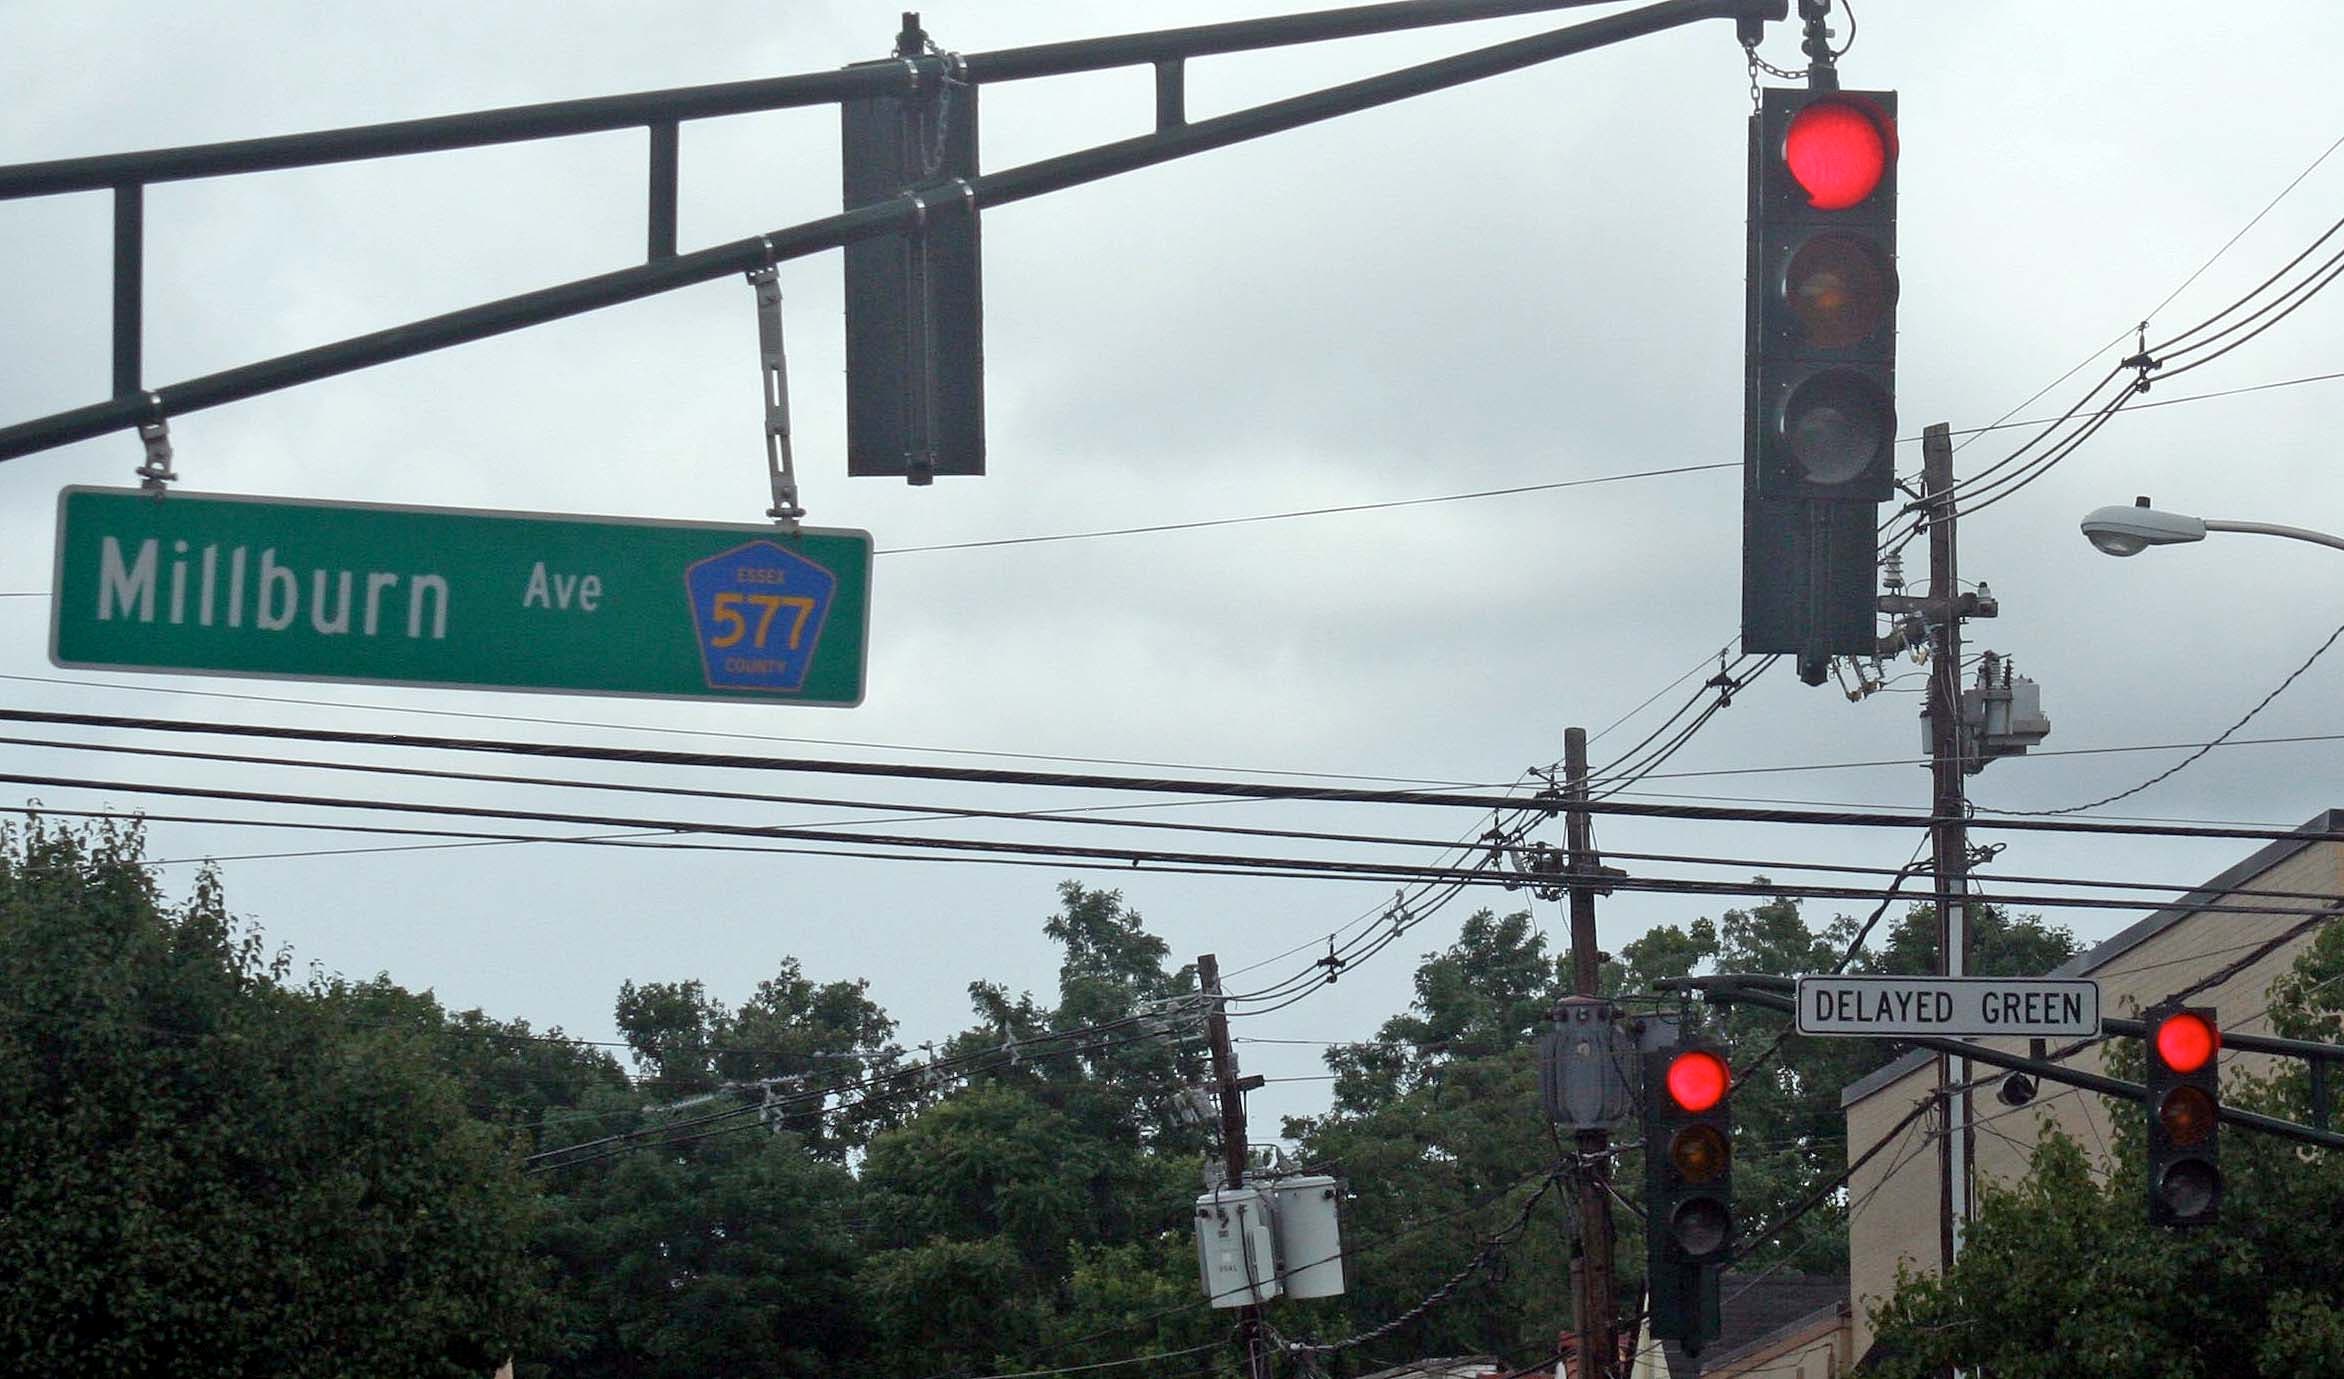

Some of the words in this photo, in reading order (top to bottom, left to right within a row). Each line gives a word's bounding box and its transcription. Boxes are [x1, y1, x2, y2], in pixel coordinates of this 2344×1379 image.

[97, 536, 448, 639] Millburn
[522, 561, 603, 611] Ave
[737, 567, 785, 584] ESSEX
[711, 592, 816, 650] 577
[725, 656, 788, 674] COUNTY
[1816, 990, 1953, 1023] DELAYED
[1982, 991, 2081, 1024] GREEN
